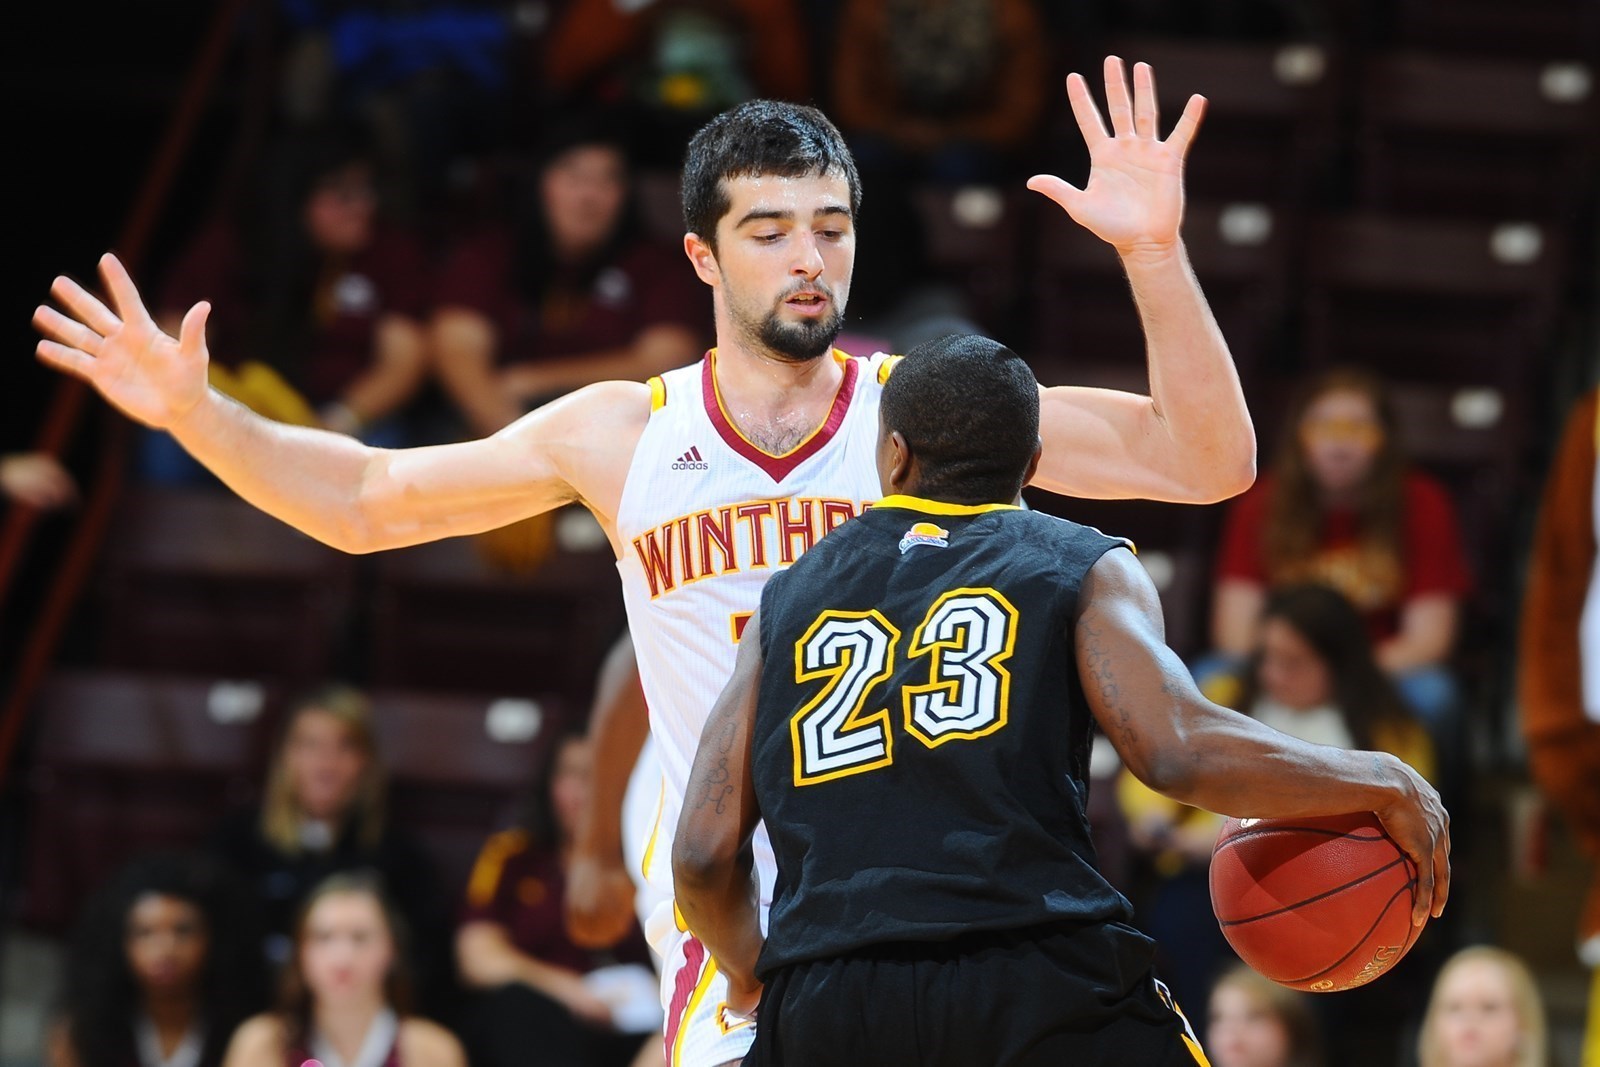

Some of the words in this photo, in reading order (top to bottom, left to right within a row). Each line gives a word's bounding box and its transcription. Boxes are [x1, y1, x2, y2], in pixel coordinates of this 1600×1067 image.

[671, 460, 709, 471] adidas
[632, 497, 881, 600] WINTH
[790, 587, 1019, 787] 23
